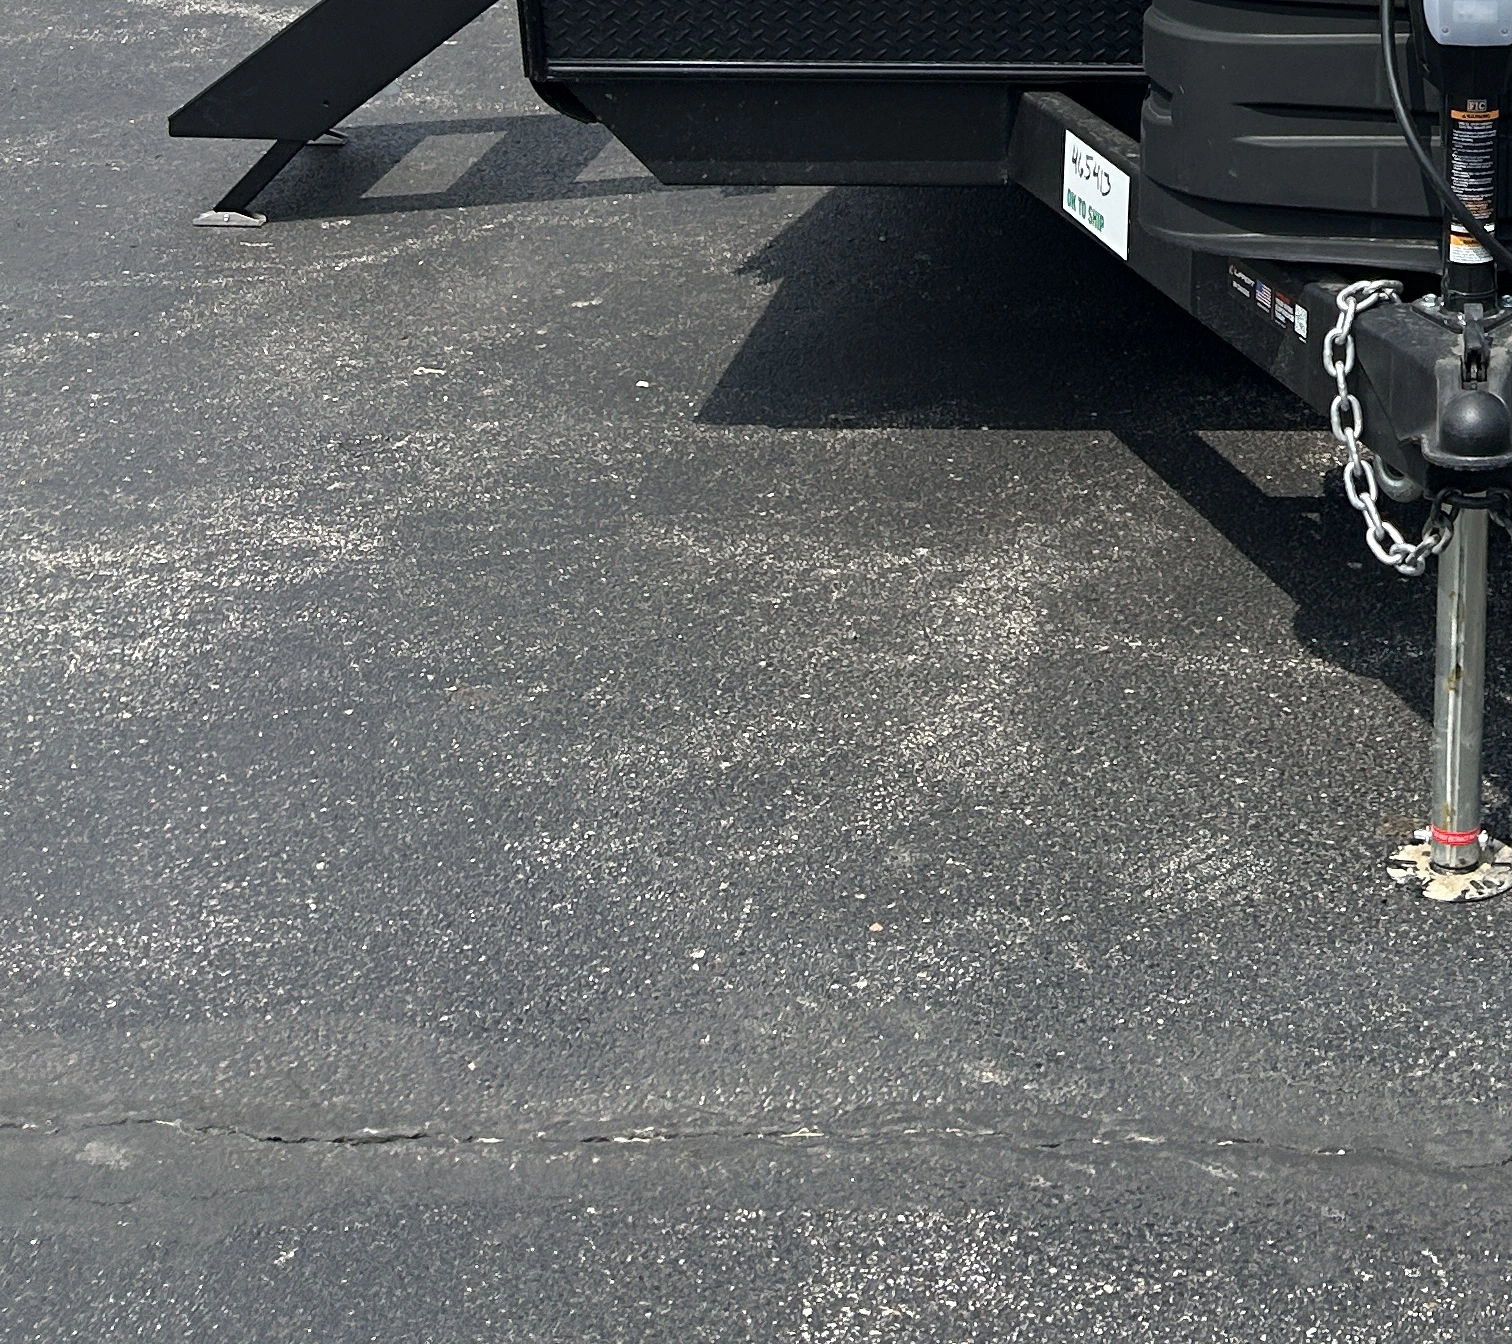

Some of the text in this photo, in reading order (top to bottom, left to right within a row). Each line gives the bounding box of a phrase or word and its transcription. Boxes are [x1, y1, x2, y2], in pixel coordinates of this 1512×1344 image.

[1066, 187, 1105, 233] OK TO SHIP
